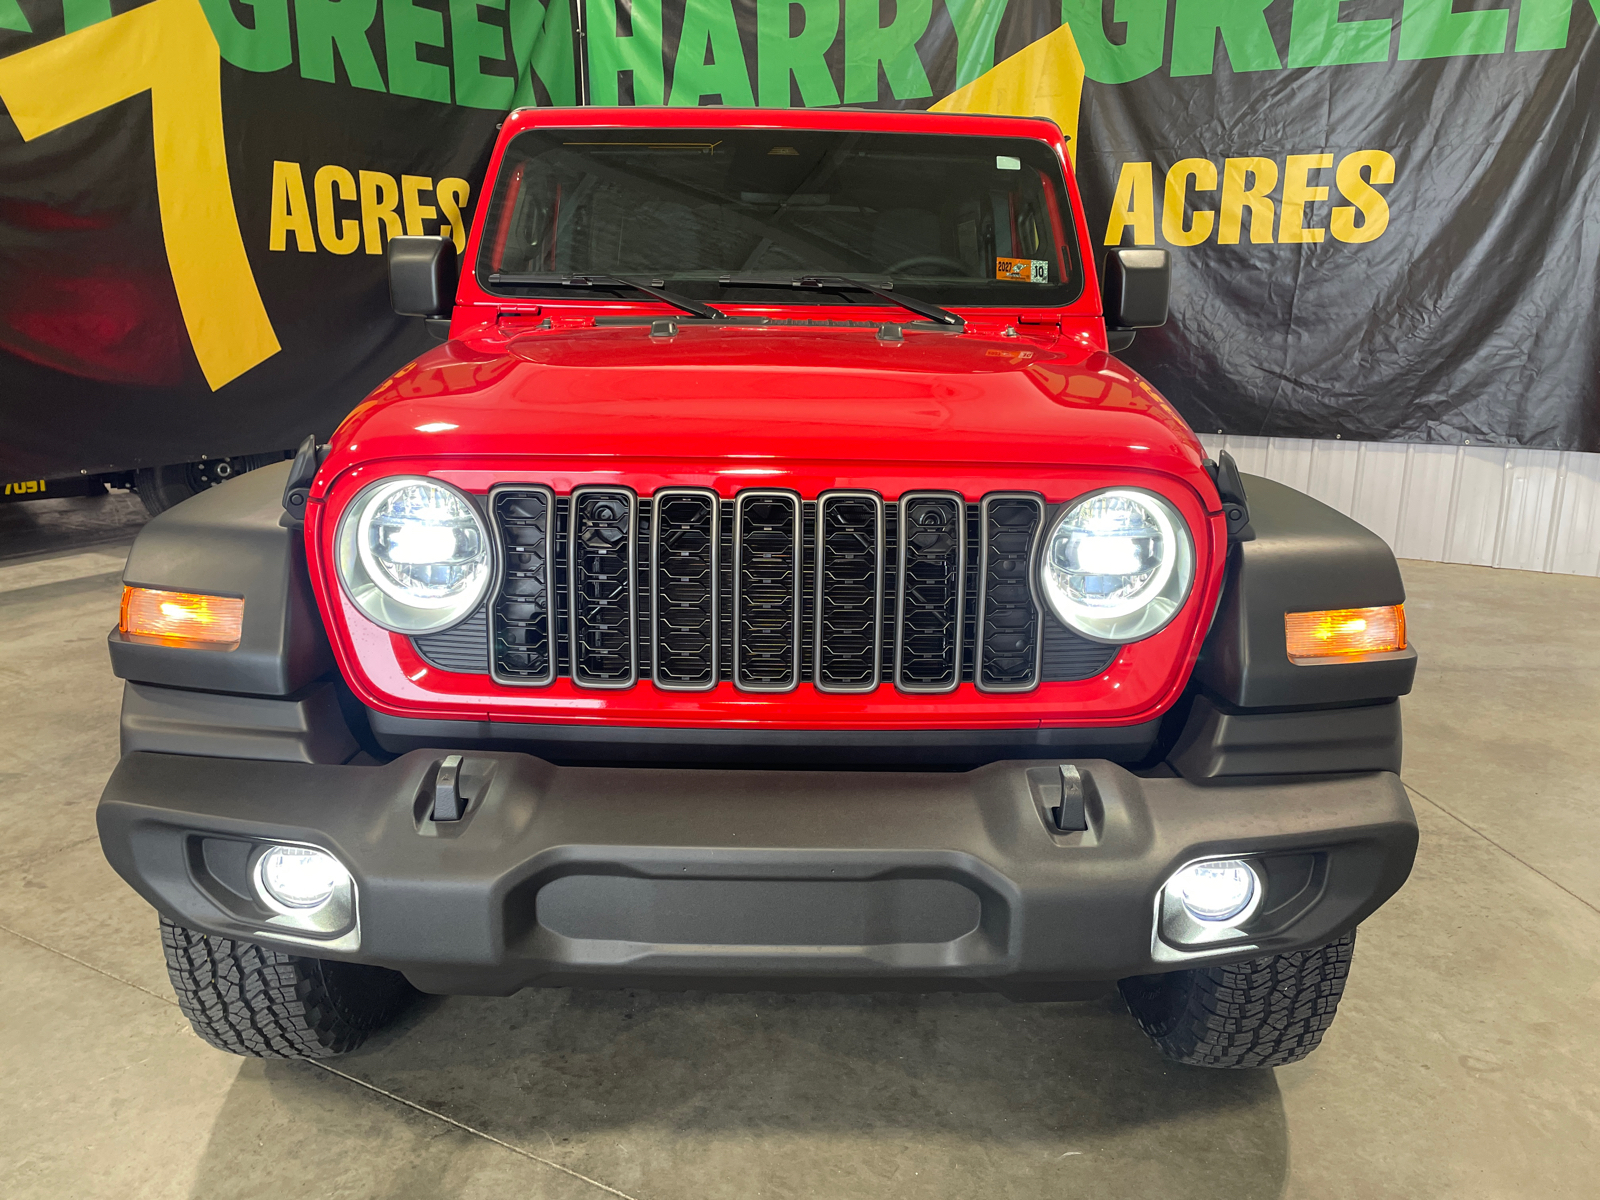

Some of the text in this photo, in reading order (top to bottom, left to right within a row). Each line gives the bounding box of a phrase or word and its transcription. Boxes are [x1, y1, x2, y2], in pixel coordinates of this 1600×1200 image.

[0, 0, 470, 391] 7 ACRES
[1104, 149, 1396, 246] ACRES
[998, 261, 1012, 273] 2027
[1035, 265, 1044, 278] 10
